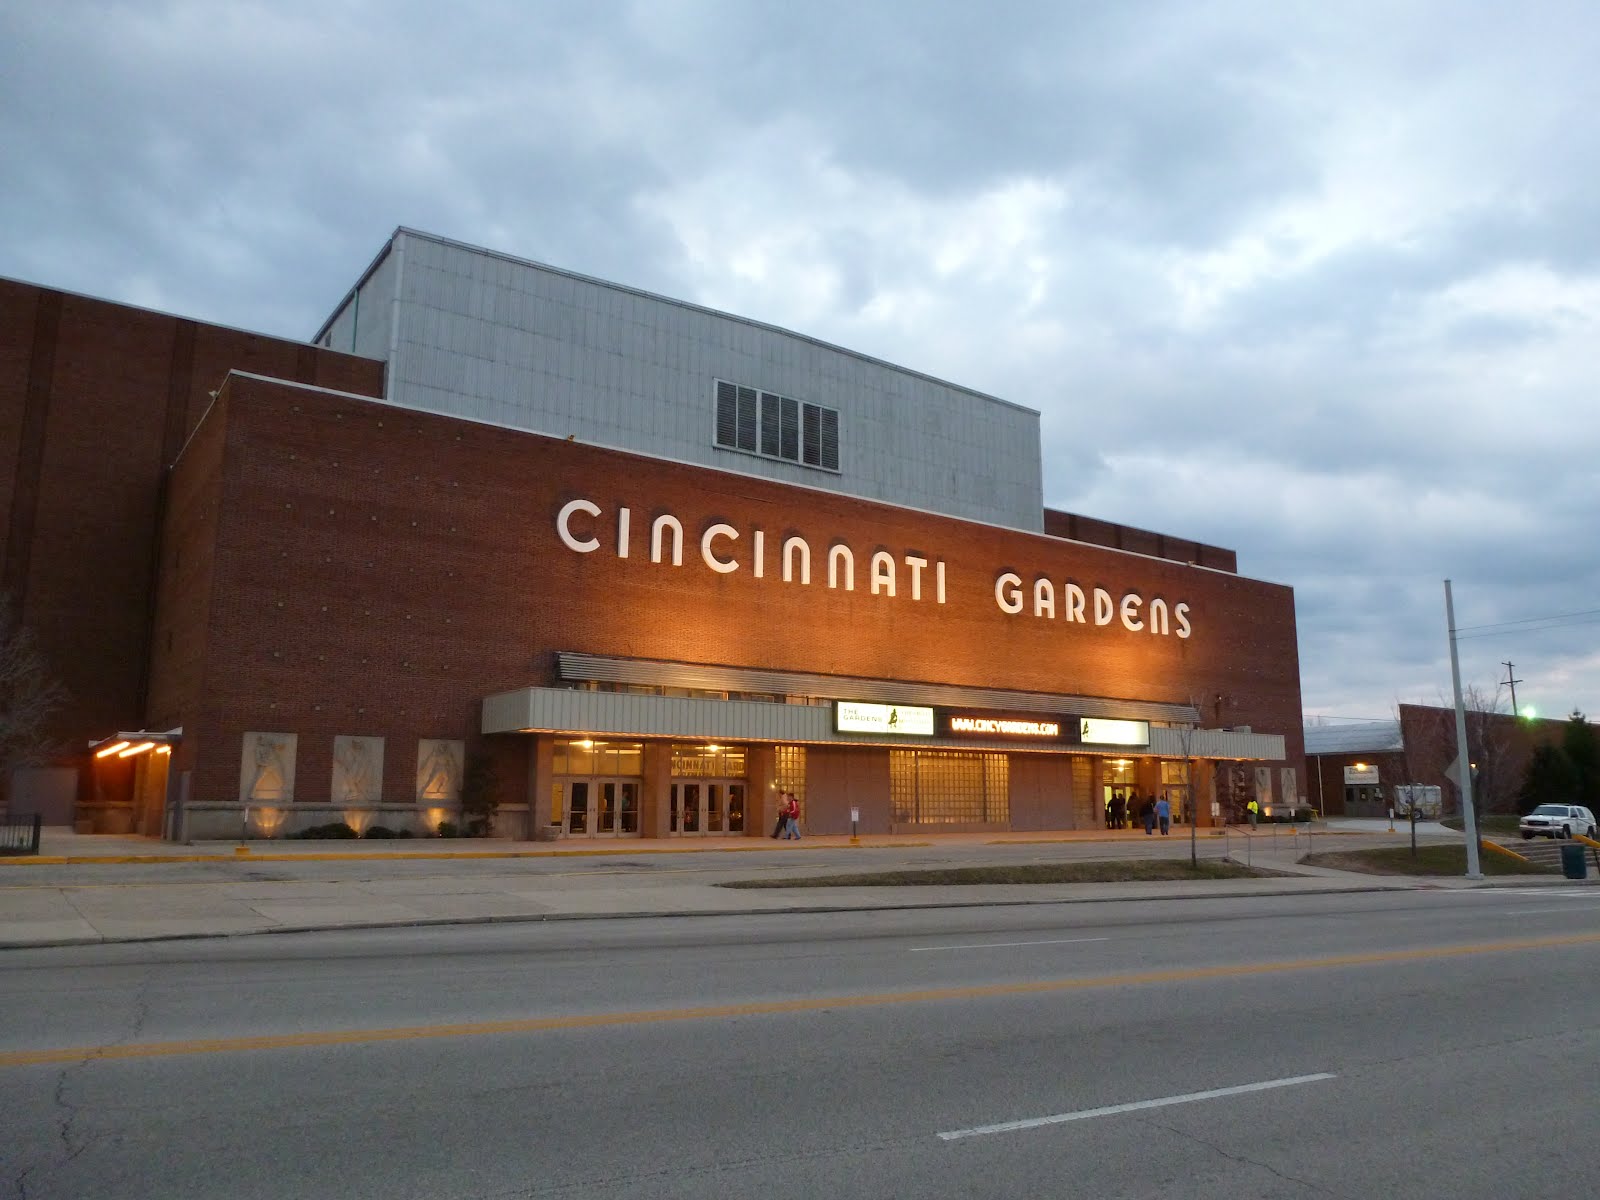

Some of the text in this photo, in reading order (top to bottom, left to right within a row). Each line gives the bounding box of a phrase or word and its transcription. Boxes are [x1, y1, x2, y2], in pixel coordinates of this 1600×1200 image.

[556, 499, 1192, 638] CINCINNATI GARDENS
[843, 714, 883, 723] GARDENS
